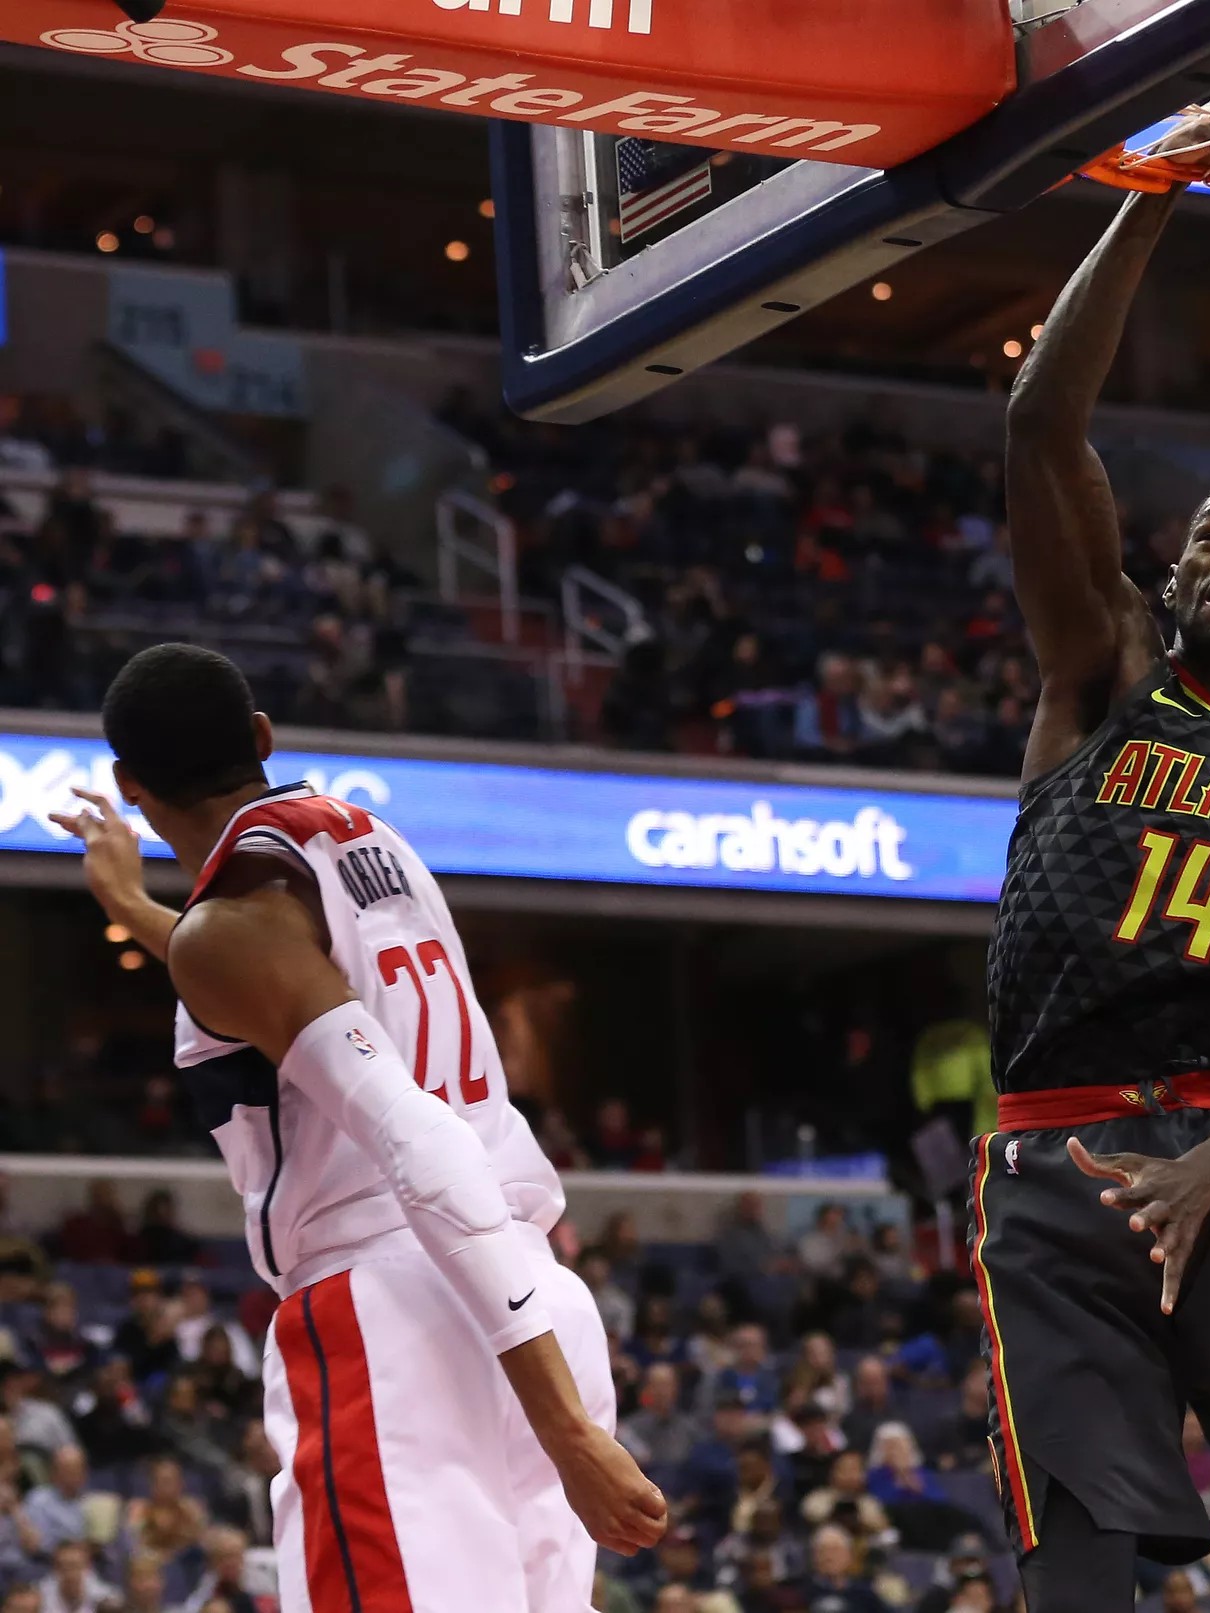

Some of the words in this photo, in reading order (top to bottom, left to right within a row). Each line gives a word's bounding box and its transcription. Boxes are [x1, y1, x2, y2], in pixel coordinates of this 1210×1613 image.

[337, 847, 414, 910] ORTER
[625, 800, 914, 880] carahsoft
[377, 939, 489, 1106] 22
